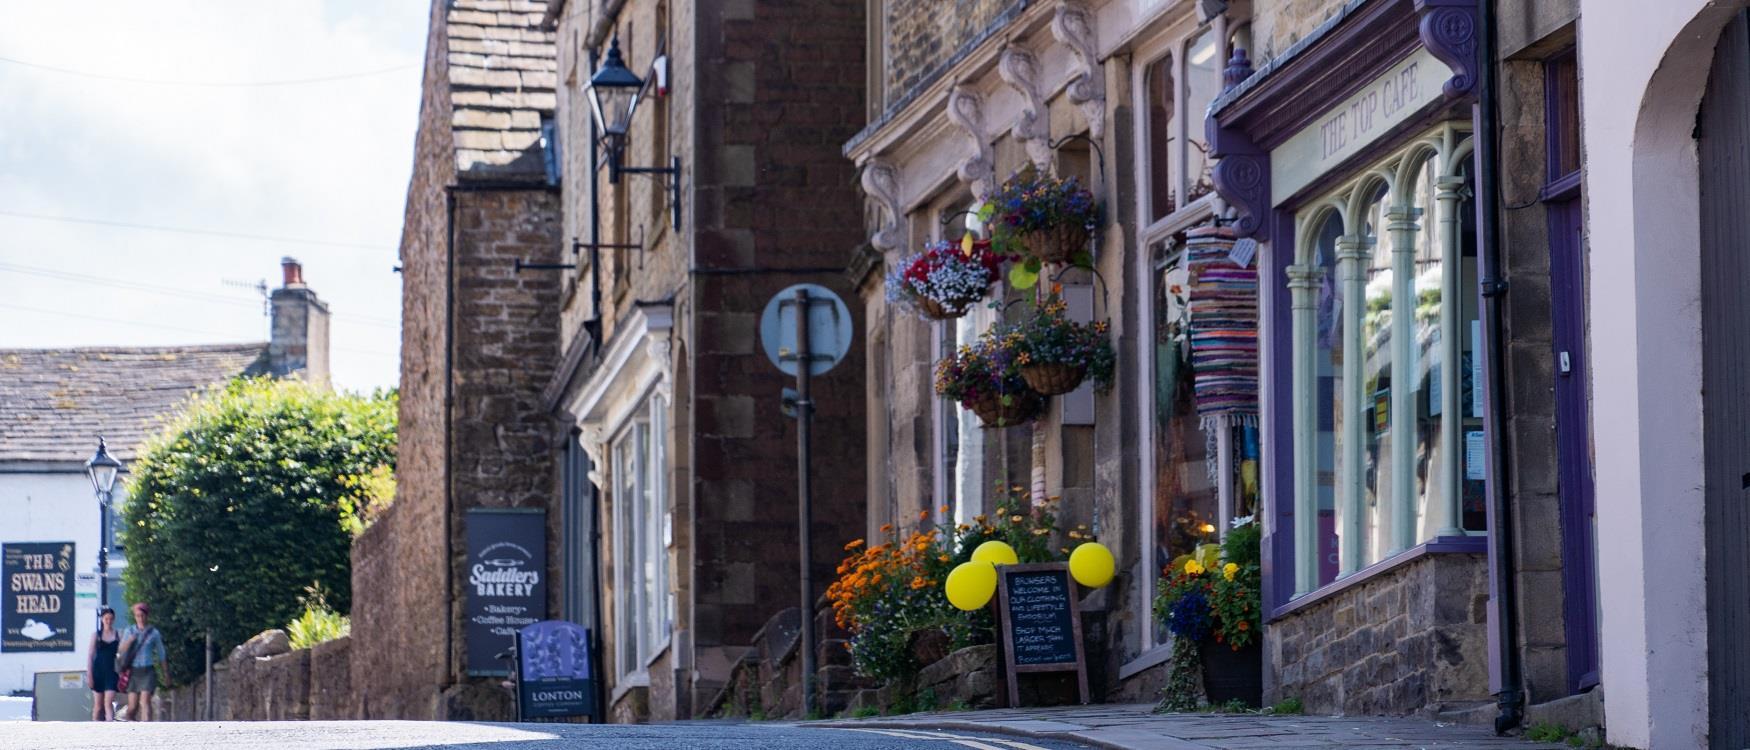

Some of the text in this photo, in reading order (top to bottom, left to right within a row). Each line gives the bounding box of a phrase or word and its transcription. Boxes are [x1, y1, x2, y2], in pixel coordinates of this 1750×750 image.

[1320, 61, 1418, 160] THE TOP CAFE
[24, 554, 53, 569] THE
[469, 564, 539, 585] Saddlers
[1015, 576, 1056, 586] BROWSERS
[12, 573, 65, 591] SWANS
[477, 583, 533, 597] BAKERY
[1012, 586, 1050, 594] WELCOME
[16, 595, 60, 613] HEAD
[1026, 594, 1066, 603] CLOTHING
[488, 604, 521, 615] Bakery
[476, 615, 505, 624] Coffee
[532, 690, 583, 702] LONTON
